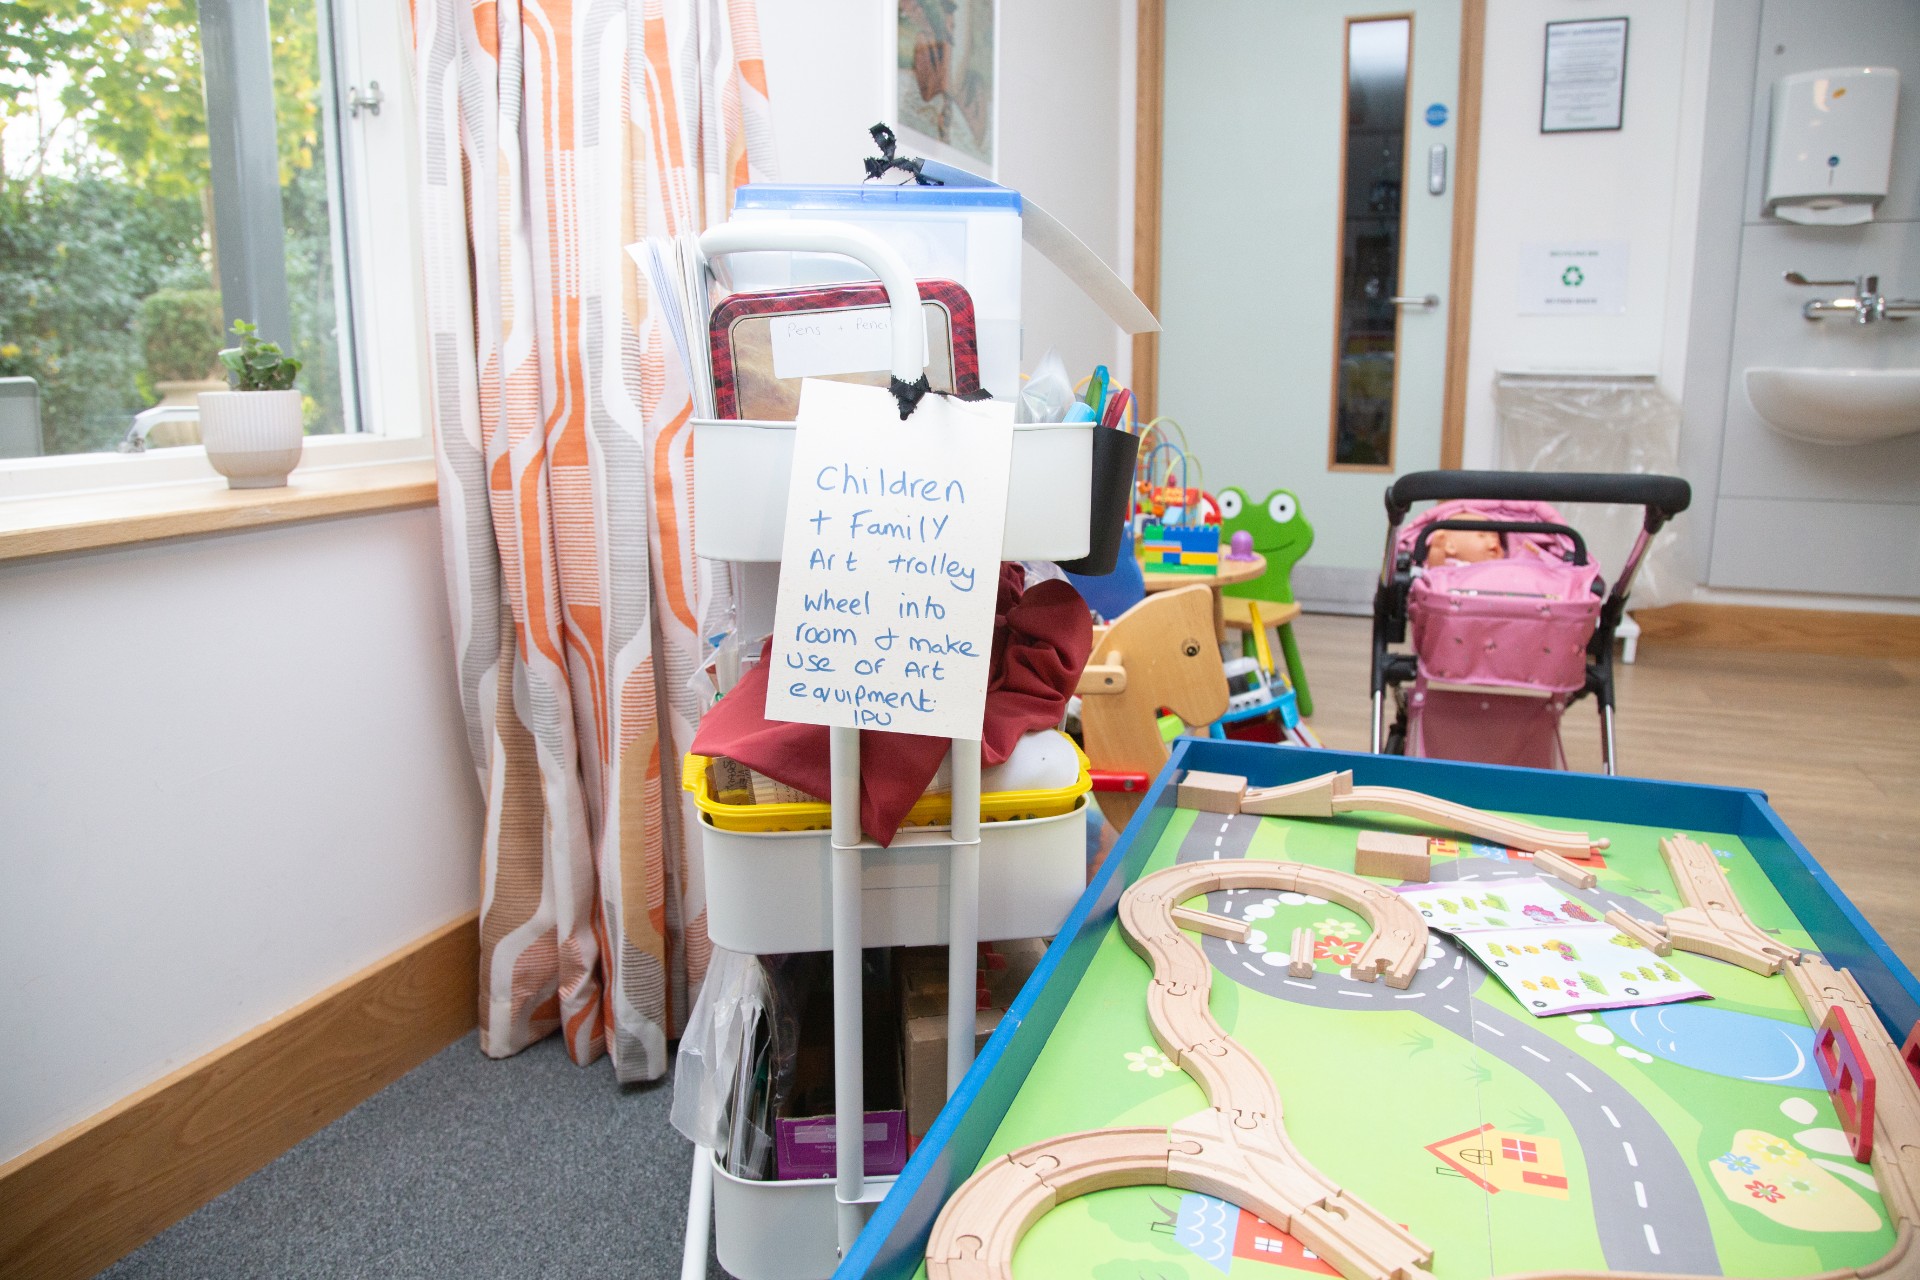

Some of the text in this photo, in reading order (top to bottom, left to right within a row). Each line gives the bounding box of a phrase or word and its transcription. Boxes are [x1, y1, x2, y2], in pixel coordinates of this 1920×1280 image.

[787, 322, 820, 338] Pens
[856, 317, 891, 330] Penci
[817, 462, 964, 503] Children
[809, 508, 949, 543] + Family
[809, 548, 975, 593] Art trolley
[899, 592, 946, 620] into
[795, 621, 857, 646] room
[909, 634, 980, 658] make
[904, 660, 945, 681] Art
[854, 708, 892, 727] IPU
